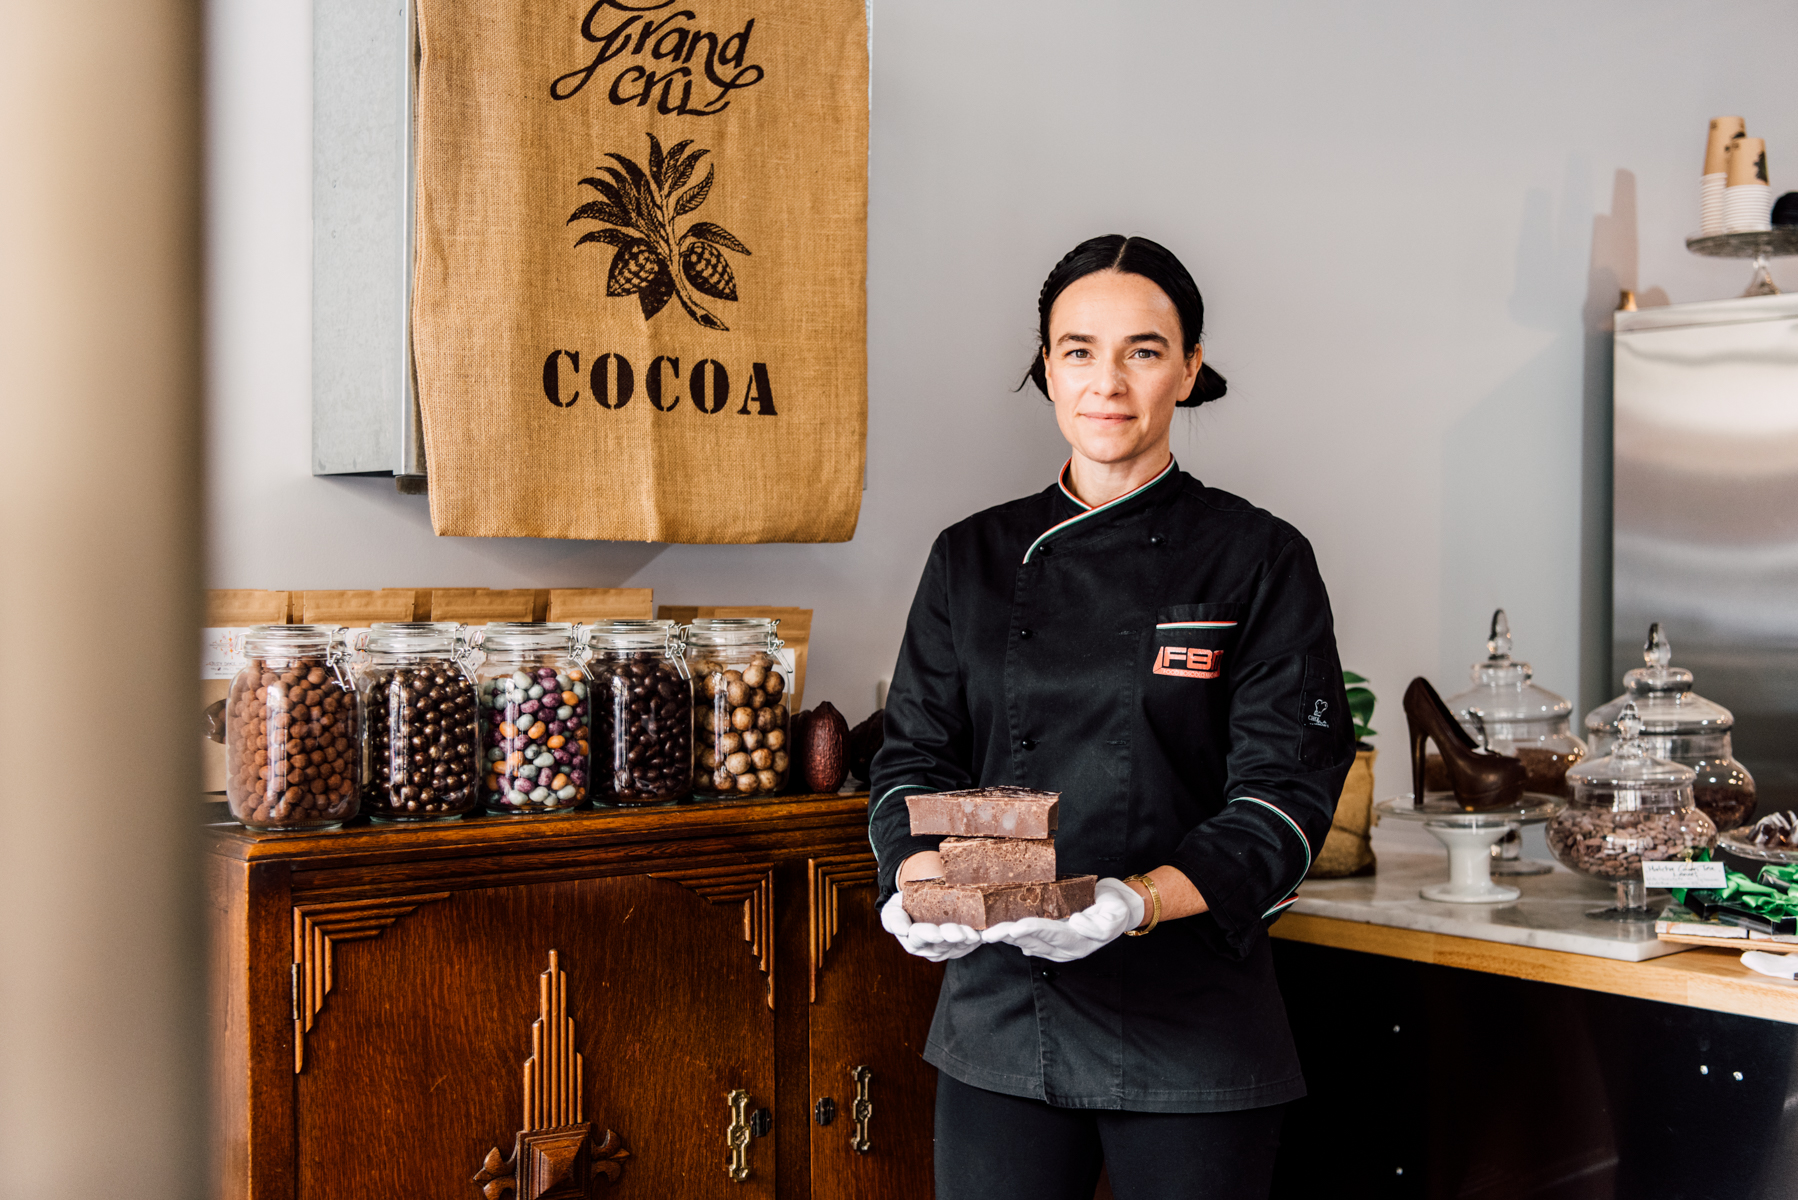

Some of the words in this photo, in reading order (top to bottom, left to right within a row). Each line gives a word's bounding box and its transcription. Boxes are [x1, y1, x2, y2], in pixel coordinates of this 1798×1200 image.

[550, 0, 764, 101] Grand
[608, 65, 731, 116] cru
[543, 350, 778, 416] COCOA
